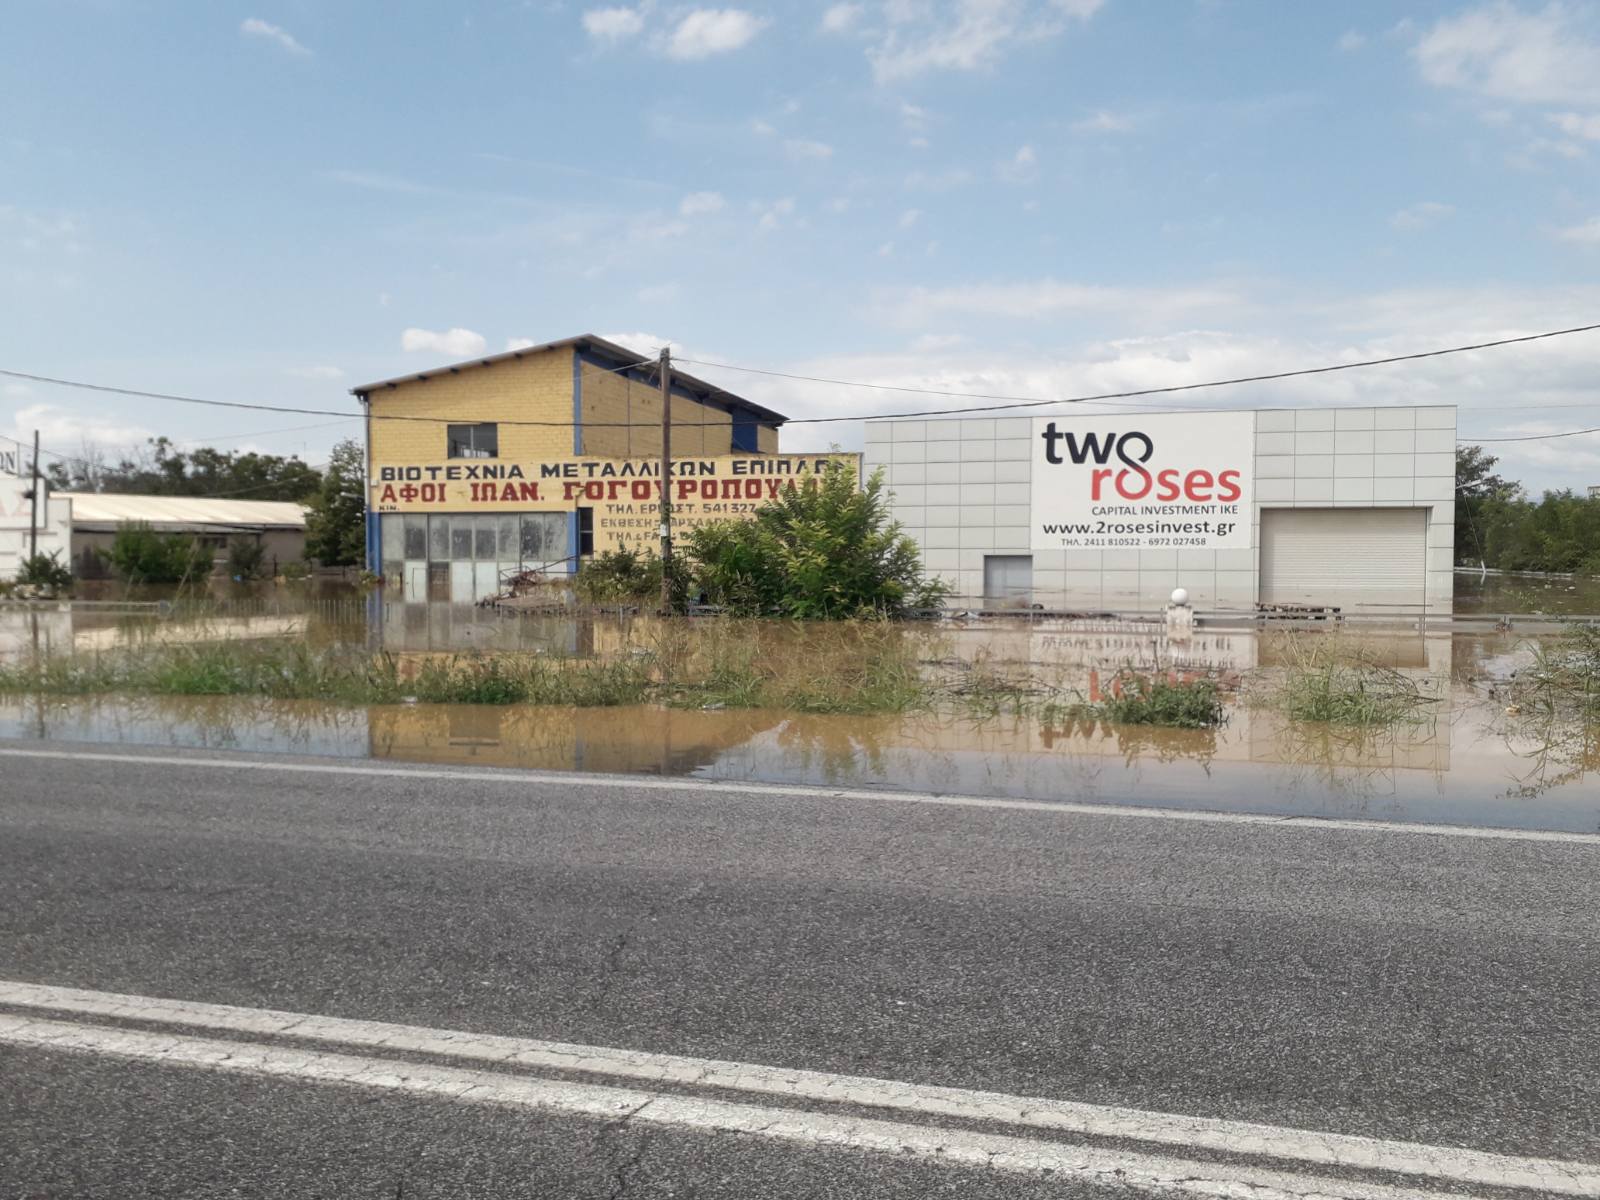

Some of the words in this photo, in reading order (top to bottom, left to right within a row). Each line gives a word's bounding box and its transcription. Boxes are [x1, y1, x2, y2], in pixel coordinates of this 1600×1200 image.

[1041, 422, 1154, 466] two
[380, 465, 525, 481] ΒΙΟΤΕΧΝΙΑ
[380, 483, 447, 502] ΑΦΟΙ
[1091, 468, 1242, 502] roses
[1091, 506, 1137, 516] CAPITAL
[1140, 505, 1217, 515] INVESTMENT
[1220, 505, 1239, 515] IKE
[1043, 520, 1236, 536] www.2rosesinvest.gr
[1061, 538, 1082, 546] ΤΗΛ.
[1084, 538, 1105, 546] 2411
[1108, 538, 1140, 546] 810522
[1148, 537, 1170, 546] 6972
[1173, 537, 1206, 546] 027458
